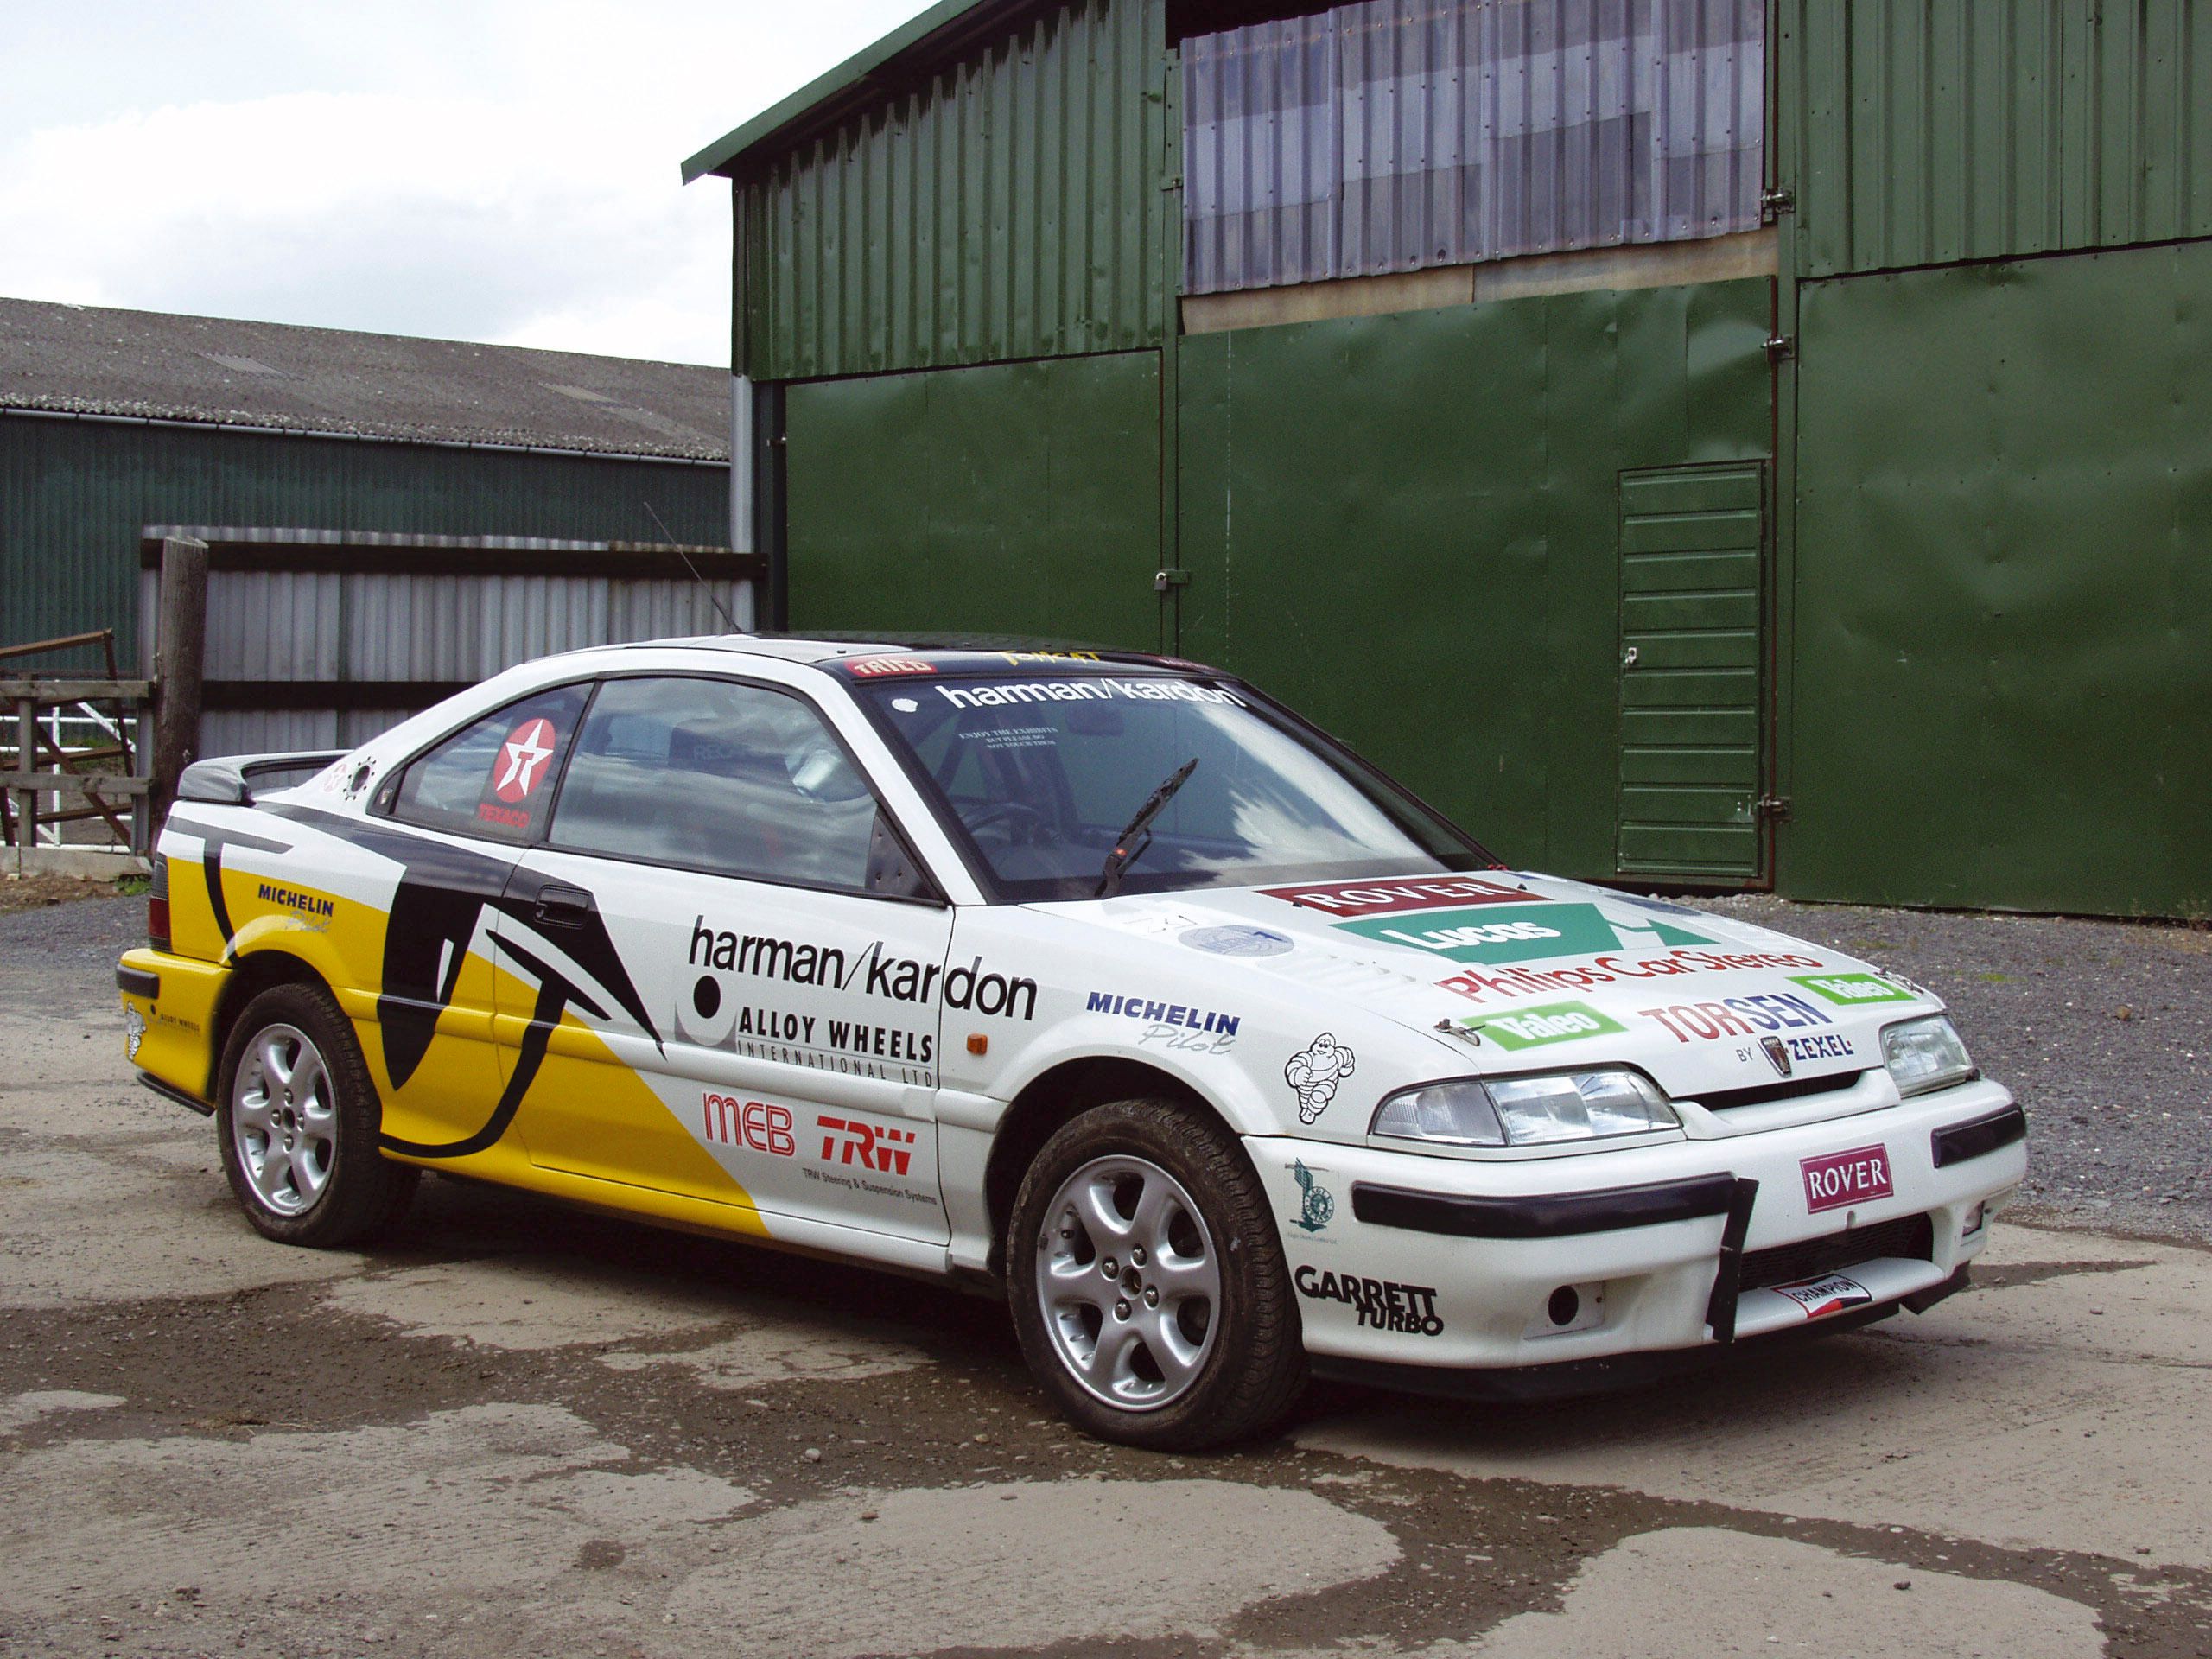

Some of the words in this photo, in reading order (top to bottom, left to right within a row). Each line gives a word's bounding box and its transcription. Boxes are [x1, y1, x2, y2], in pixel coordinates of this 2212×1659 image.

[854, 658, 933, 674] TRICO
[935, 677, 1248, 709] harman/kardon
[479, 803, 530, 828] TEXACO
[258, 883, 334, 918] MICHELIN
[1293, 881, 1507, 910] ROVER
[689, 914, 1038, 1020] harman/kardon
[1432, 965, 1616, 1004] Philips
[1594, 955, 1694, 978] Car
[1680, 950, 1824, 970] Stereo
[1807, 978, 1896, 998] Valeo
[1086, 991, 1241, 1037] MICHELIN
[1484, 1009, 1599, 1041] Valeo
[1637, 993, 1833, 1043] TORSEN
[739, 1007, 816, 1043] ALLOY
[829, 1020, 933, 1063] WHEELS
[1137, 1025, 1236, 1055] Pilot
[1736, 1047, 1754, 1062] BY
[1787, 1034, 1855, 1061] ZEXEL
[738, 1040, 887, 1080] INTERNATIONAL
[902, 1067, 932, 1087] LTD
[703, 1092, 795, 1157] MEB
[817, 1115, 916, 1175] TRW
[803, 1167, 820, 1180] TRW
[822, 1172, 852, 1190] Steering
[852, 1179, 860, 1189] &
[861, 1180, 904, 1198] Suspension
[905, 1189, 938, 1205] Systems
[1808, 1158, 1887, 1199] ROVER
[1294, 1265, 1438, 1317] GARRETT
[1791, 1277, 1858, 1303] CHAMPION
[1356, 1298, 1445, 1337] TURBO
